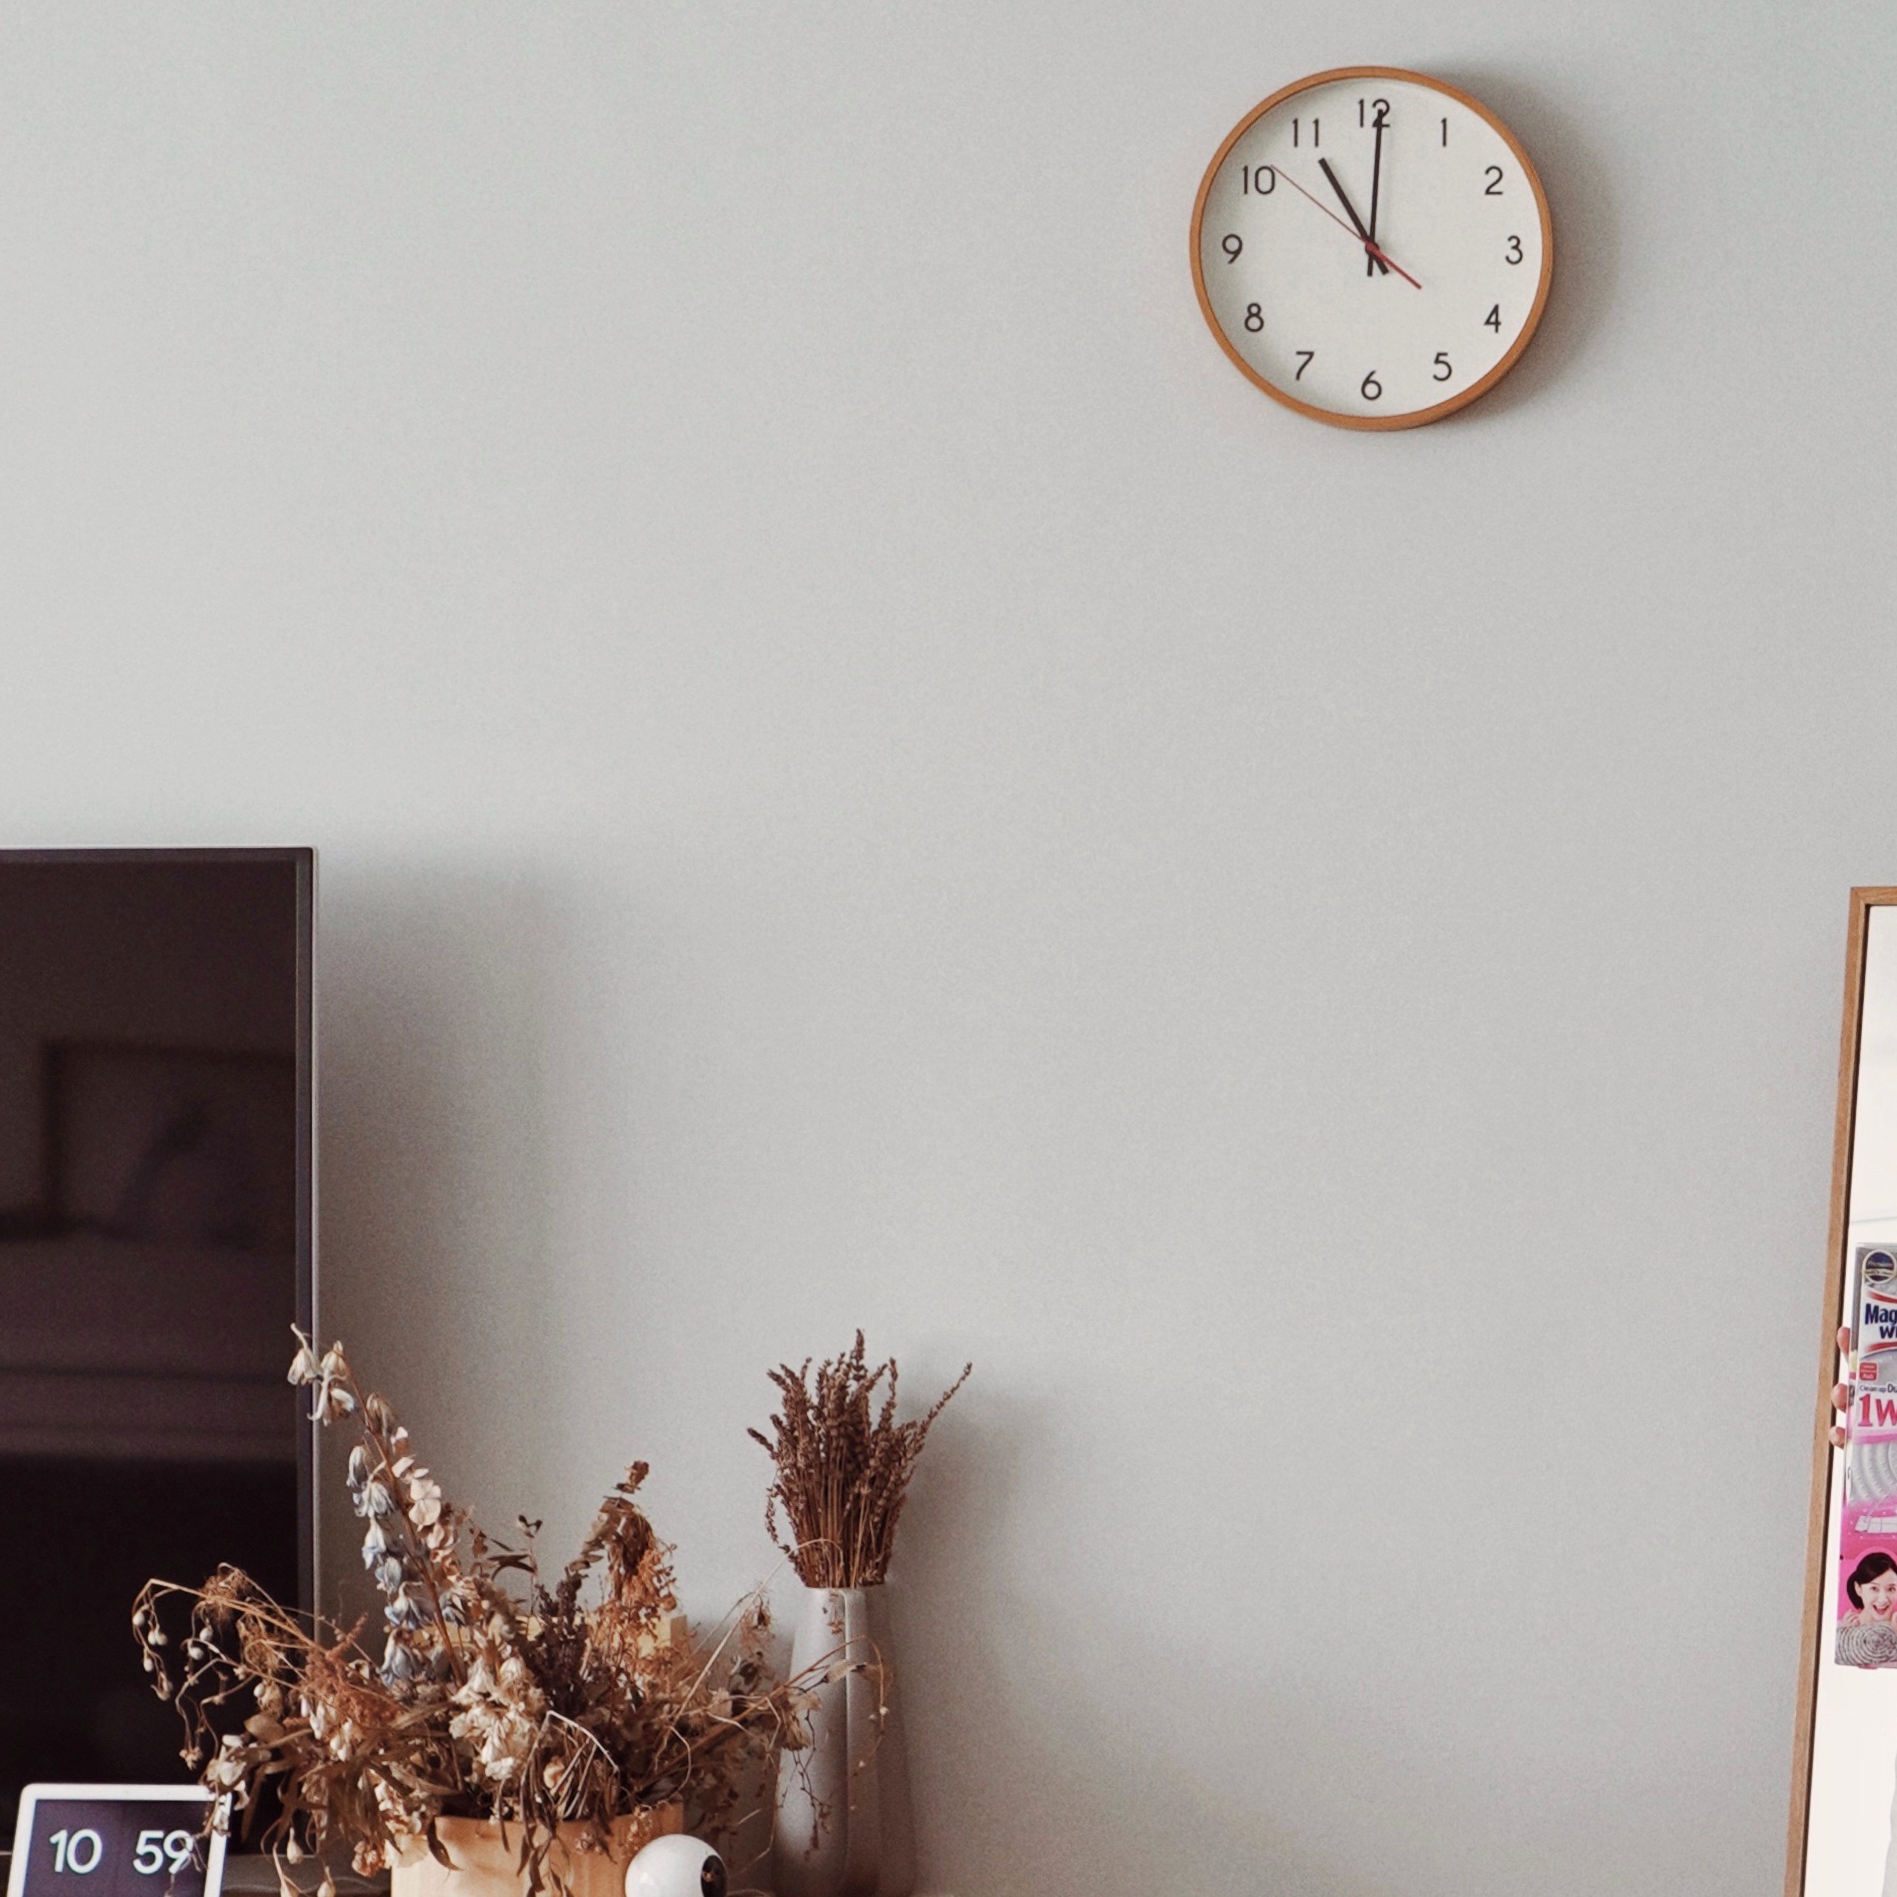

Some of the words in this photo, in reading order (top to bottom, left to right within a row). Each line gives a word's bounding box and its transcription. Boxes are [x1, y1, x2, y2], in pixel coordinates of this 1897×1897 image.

[1357, 98, 1391, 128] 12
[1291, 118, 1320, 147] 11
[1440, 117, 1448, 147] 1
[1242, 165, 1276, 195] 10
[1484, 166, 1504, 195] 2
[1221, 234, 1243, 264] 9
[1505, 235, 1524, 265] 3
[1244, 303, 1265, 333] 8
[1483, 304, 1502, 333] 4
[1295, 351, 1315, 381] 7
[1433, 352, 1453, 382] 5
[1361, 370, 1382, 400] 6
[1858, 1394, 1873, 1427] 1
[49, 1828, 103, 1874] 10
[132, 1829, 194, 1875] 59
